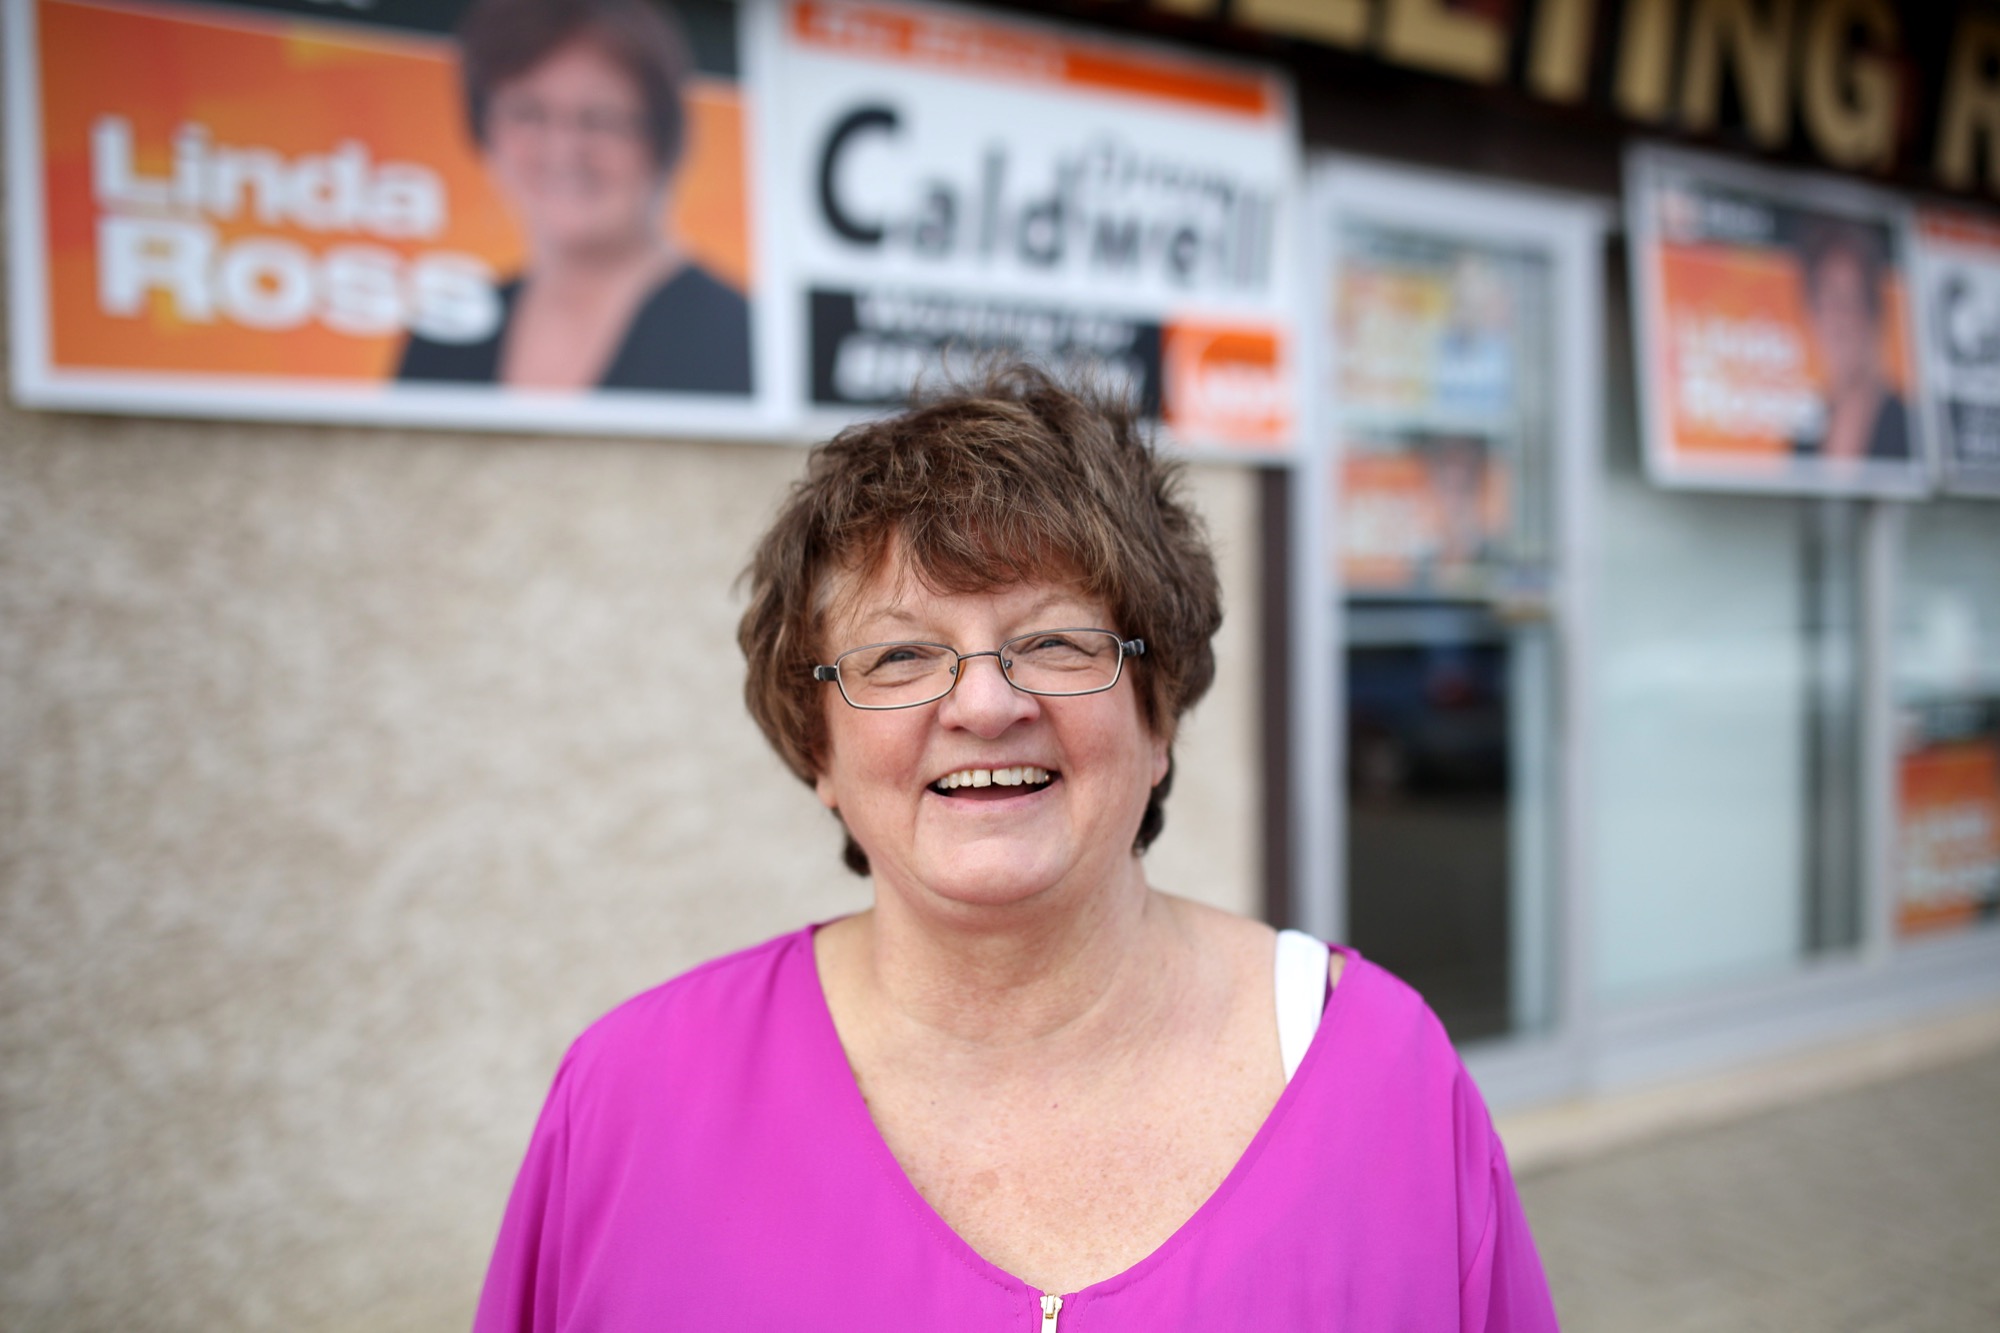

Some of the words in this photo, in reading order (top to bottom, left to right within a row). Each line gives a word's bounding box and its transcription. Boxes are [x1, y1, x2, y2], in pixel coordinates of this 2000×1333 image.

[1150, 0, 1902, 168] TING
[92, 113, 446, 240] Linda
[815, 104, 1276, 291] Caldwell
[98, 214, 502, 343] Ross
